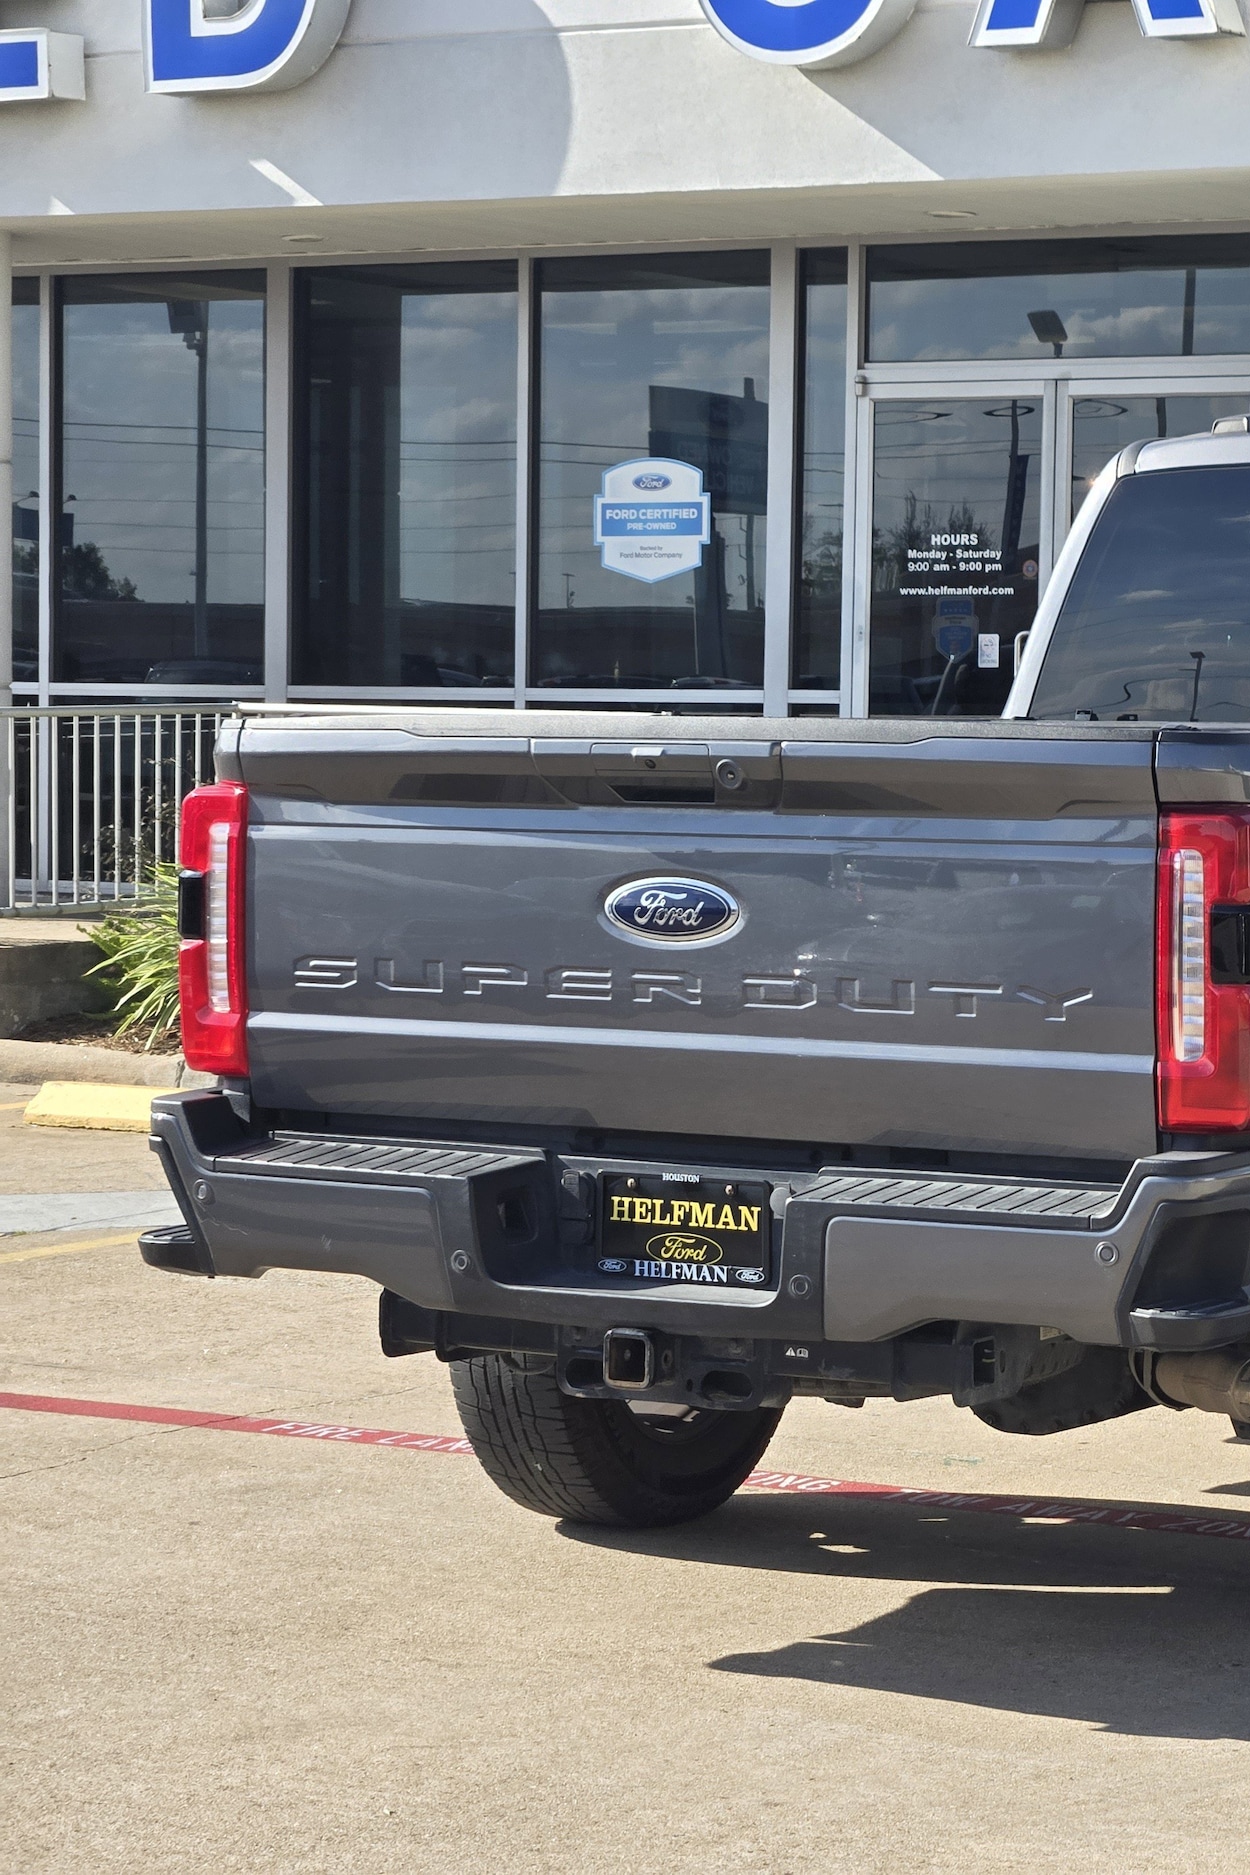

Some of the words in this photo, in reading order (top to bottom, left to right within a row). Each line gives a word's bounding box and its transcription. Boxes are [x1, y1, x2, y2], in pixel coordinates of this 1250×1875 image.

[639, 475, 665, 488] Ford
[605, 509, 638, 520] FORD
[638, 508, 698, 519] CERTIFIED
[626, 522, 677, 531] PRE-OWNED
[931, 534, 979, 546] HOURS
[907, 549, 947, 560] Monday
[955, 549, 1002, 560] Saturday
[907, 562, 930, 572] 9:00
[933, 563, 950, 572] am
[959, 562, 983, 571] 9:00
[984, 563, 1002, 573] pm
[900, 585, 1014, 596] www.helfmanford.com
[633, 889, 705, 926] Ford
[293, 954, 702, 1006] SUPER
[742, 973, 1094, 1022] DUTY
[662, 1172, 700, 1184] HOUSTON
[610, 1196, 761, 1232] HELFMAN
[660, 1236, 708, 1261] Ford
[602, 1261, 623, 1271] Ford
[634, 1259, 730, 1284] HELFMAN
[740, 1270, 760, 1281] Ford
[261, 1422, 380, 1440] FIRE
[375, 1433, 476, 1454] LAN
[882, 1488, 992, 1507] TOW
[993, 1502, 1152, 1525] AWAY
